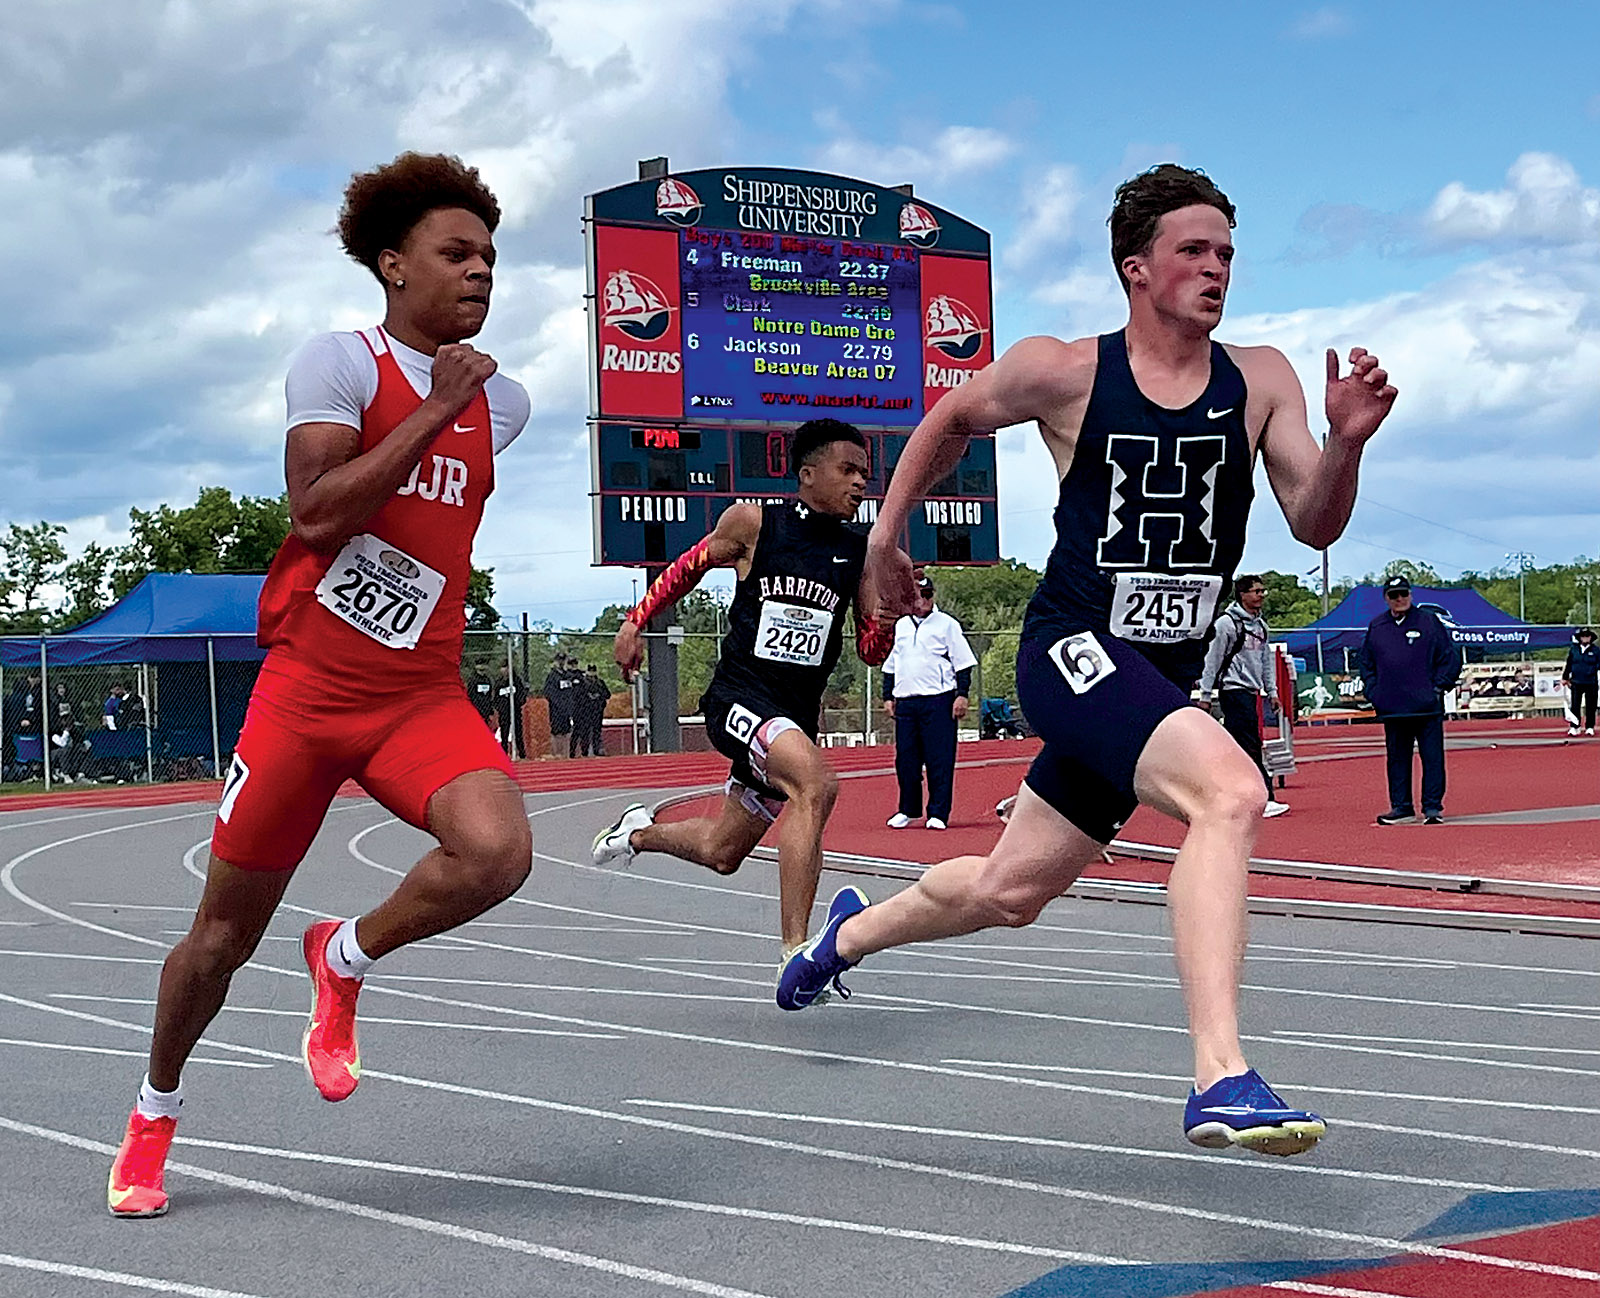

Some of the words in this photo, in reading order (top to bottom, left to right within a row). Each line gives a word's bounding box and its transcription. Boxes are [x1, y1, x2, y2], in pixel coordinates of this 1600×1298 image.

[723, 174, 877, 216] SHIPPENSBURG
[738, 203, 864, 238] UNIVERSITY
[686, 248, 699, 265] 4
[721, 251, 802, 273] Freeman
[839, 261, 890, 280] 22.37
[687, 292, 699, 307] 5
[753, 316, 804, 336] Notre
[810, 319, 860, 338] Dame
[865, 323, 896, 341] Gre
[601, 343, 681, 374] RAIDERS
[687, 332, 700, 350] 6
[723, 336, 801, 355] Jackson
[843, 342, 893, 361] 22.79
[754, 357, 819, 377] Beaver
[826, 361, 869, 380] Area
[874, 364, 896, 380] 07
[924, 361, 977, 388] RAIDE
[703, 396, 733, 406] LYNX
[621, 496, 687, 522] PERIOD
[1096, 433, 1227, 568] H
[331, 567, 418, 635] 2670
[758, 574, 840, 612] HARRITON
[1122, 592, 1201, 629] 2451
[348, 610, 394, 642] ATHLETIC
[1451, 630, 1484, 642] Cross
[1485, 631, 1530, 645] Country
[764, 627, 821, 656] 2420
[1060, 637, 1103, 684] 6
[728, 710, 752, 738] 5
